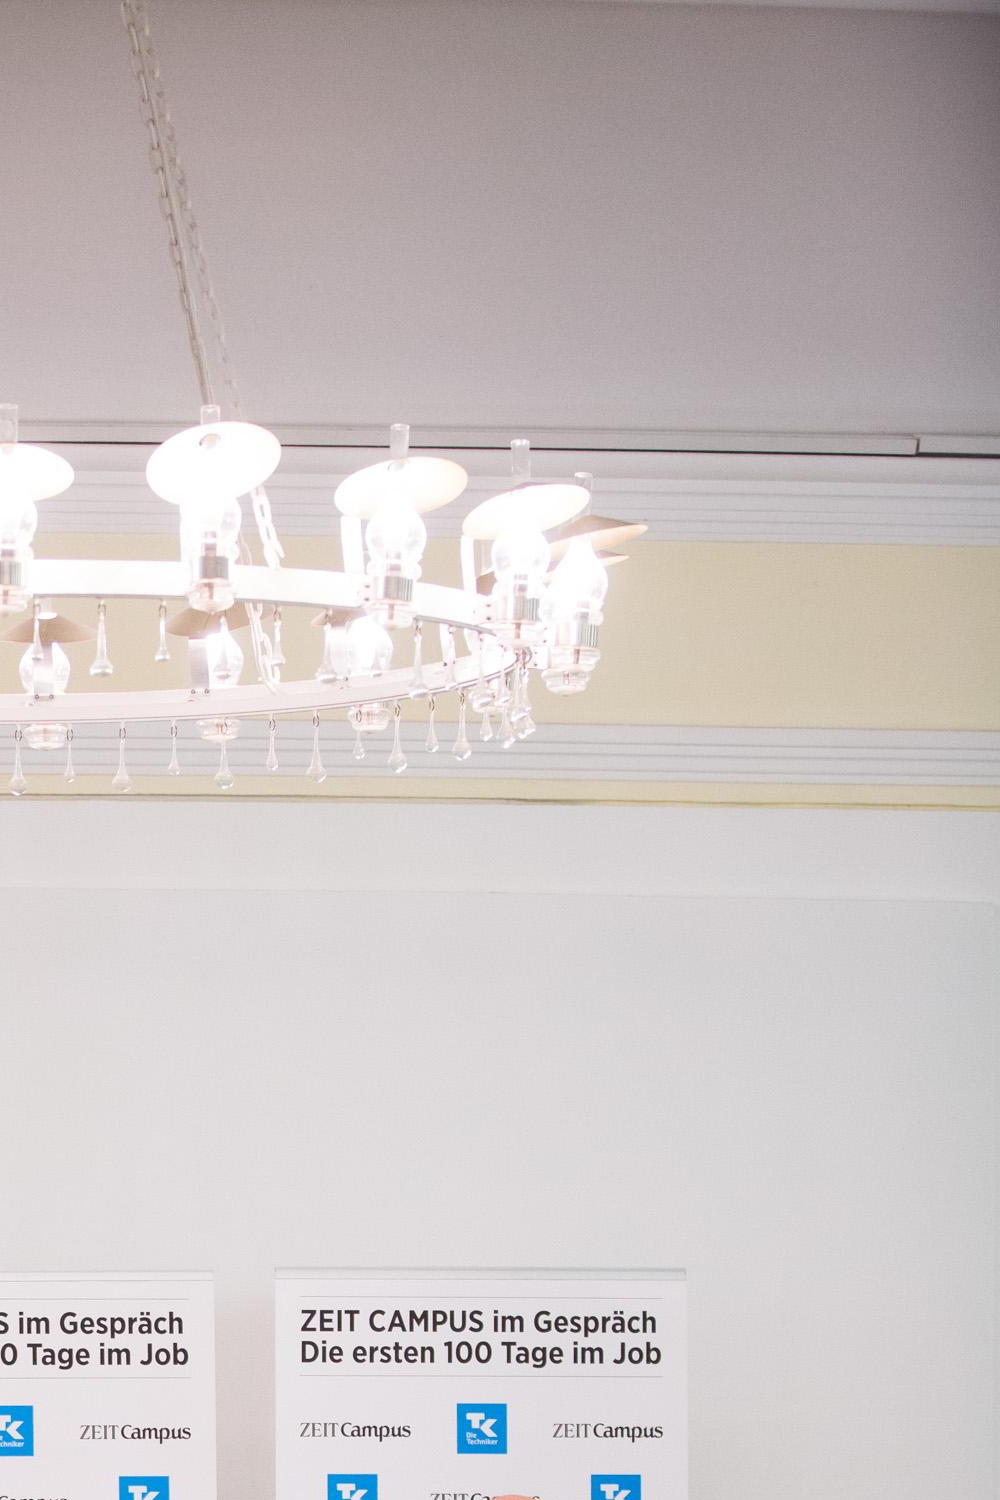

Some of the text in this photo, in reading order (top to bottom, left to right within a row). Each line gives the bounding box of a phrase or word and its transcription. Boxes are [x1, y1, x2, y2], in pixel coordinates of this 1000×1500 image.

[19, 1312, 50, 1335] im
[60, 1311, 183, 1339] Gespräch
[301, 1310, 656, 1338] ZEIT CAMPUS im Gespräch
[27, 1343, 91, 1370] Tage
[100, 1343, 131, 1366] im
[140, 1343, 189, 1366] Job
[301, 1340, 661, 1368] Die ersten 100 Tage im Job
[466, 1413, 498, 1438] TK
